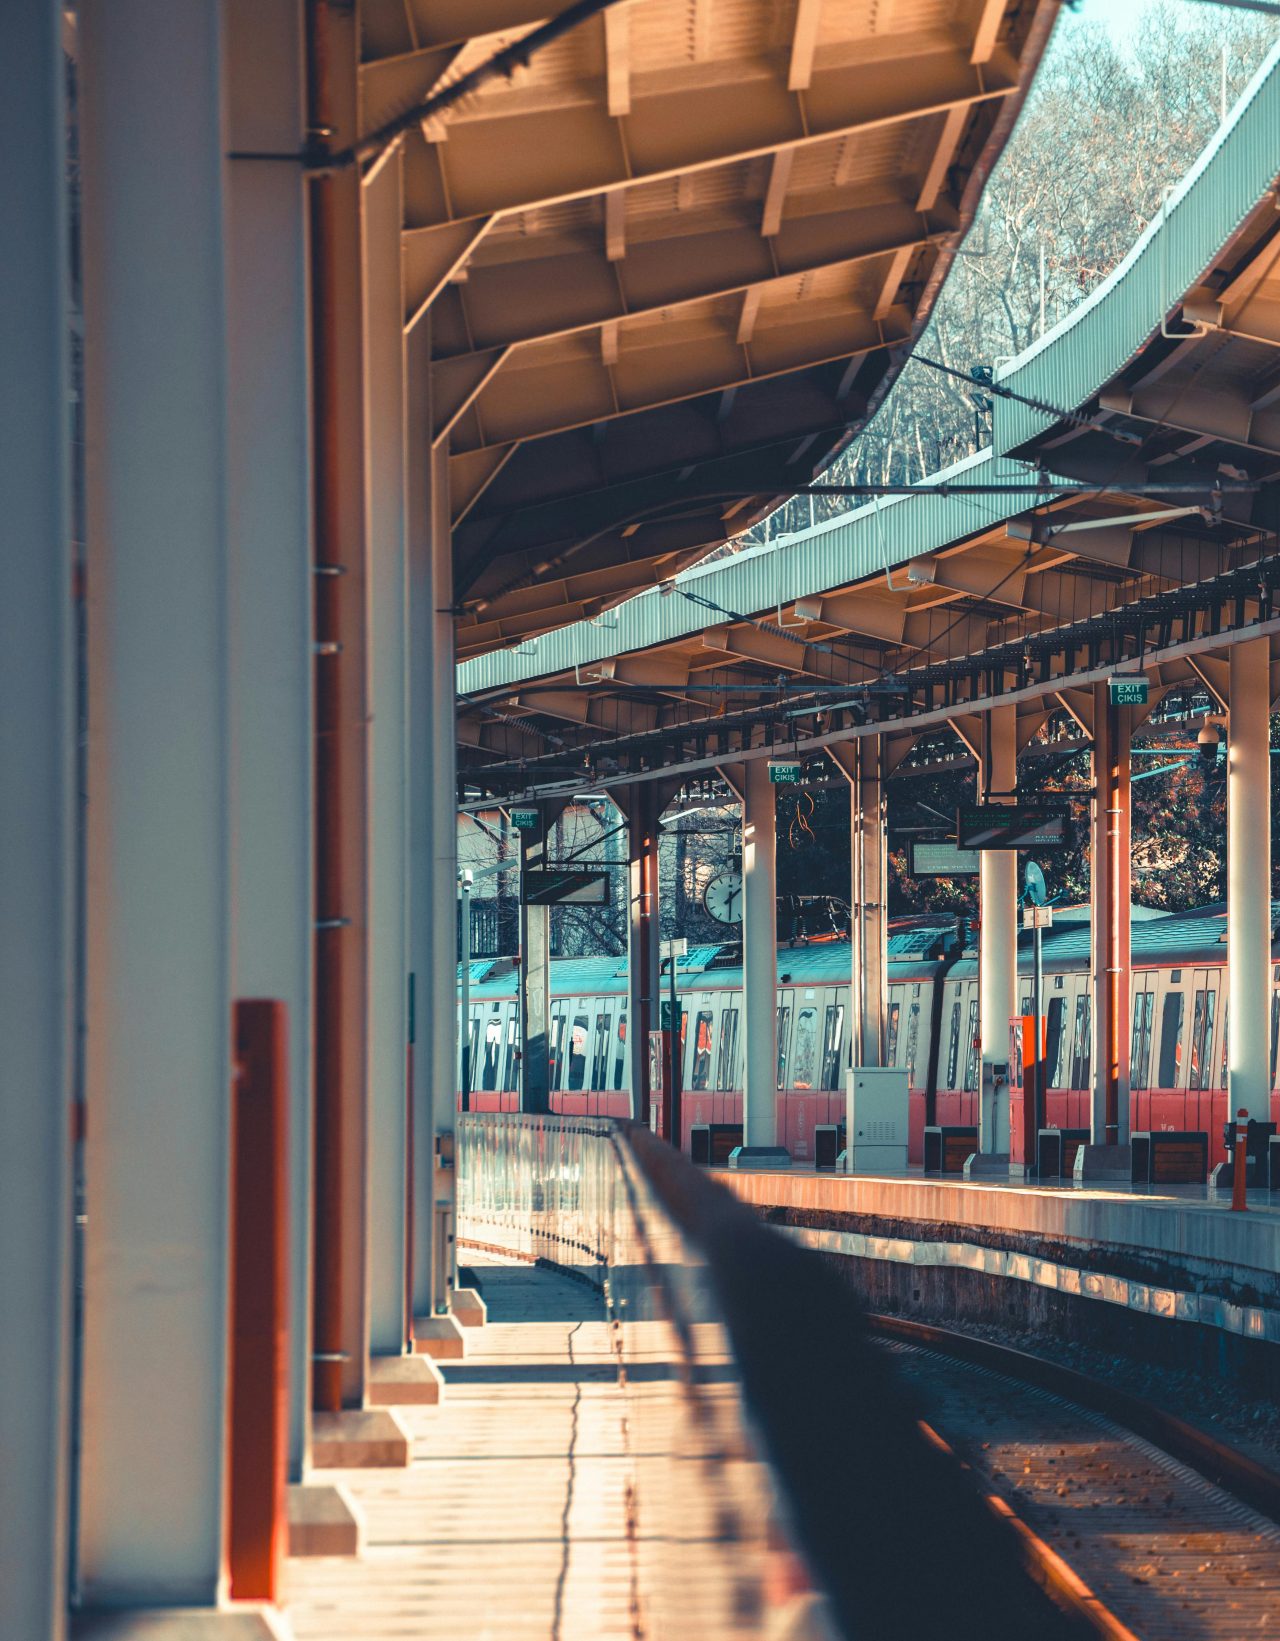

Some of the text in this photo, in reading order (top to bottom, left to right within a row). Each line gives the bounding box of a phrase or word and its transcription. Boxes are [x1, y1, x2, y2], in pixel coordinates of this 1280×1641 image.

[1117, 684, 1142, 693] EXIT
[1117, 694, 1143, 704] ÇIKIŞ
[775, 766, 794, 774] EXIT
[774, 774, 795, 782] ÇIKIŞ
